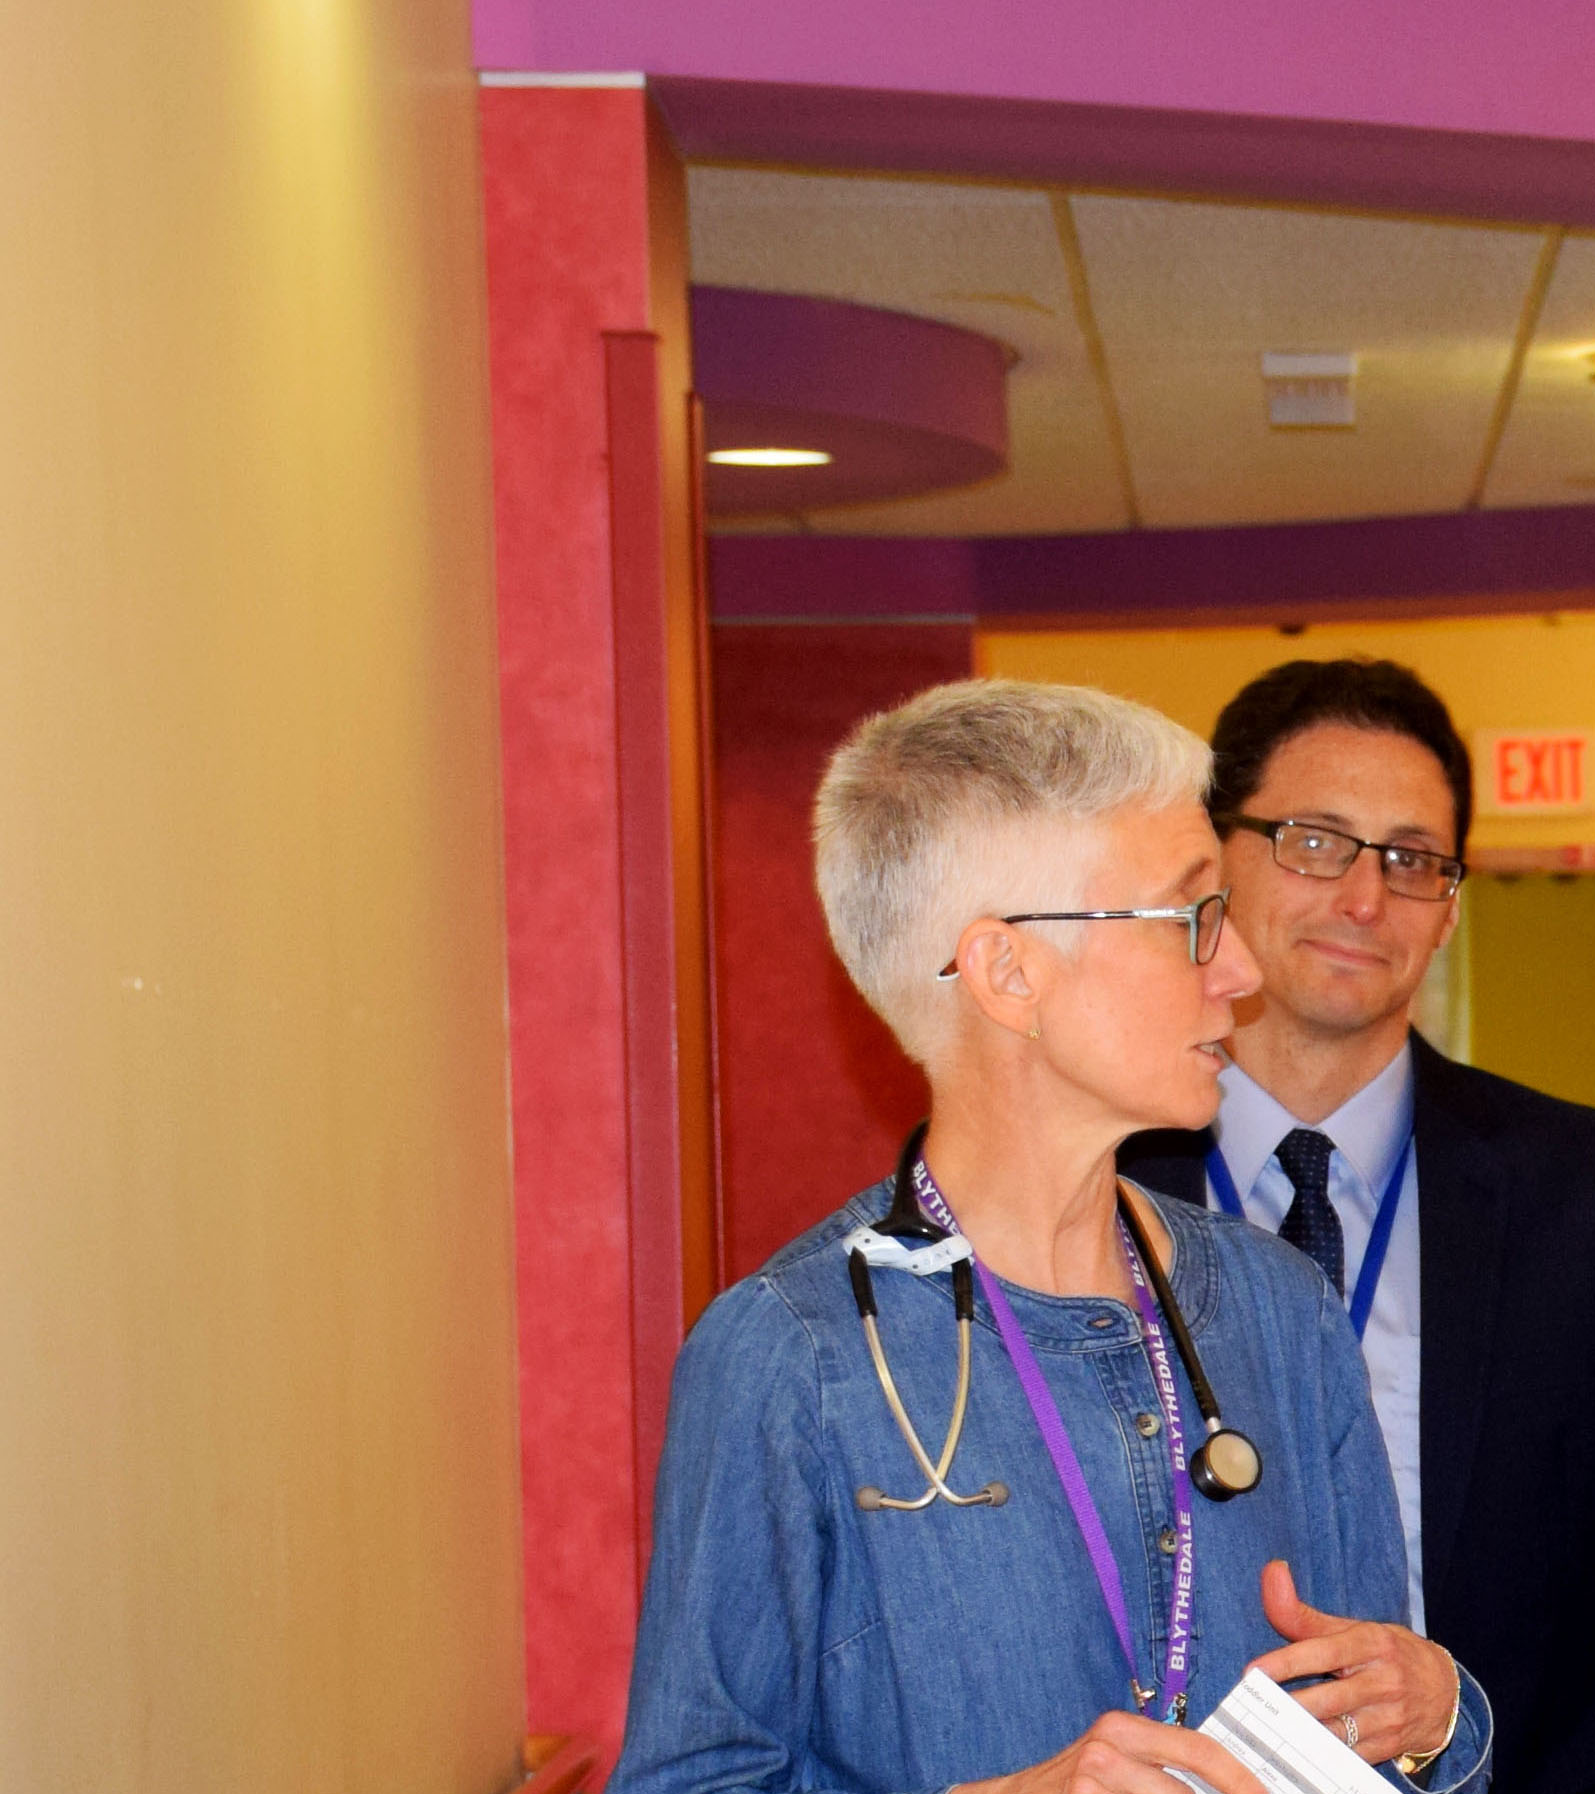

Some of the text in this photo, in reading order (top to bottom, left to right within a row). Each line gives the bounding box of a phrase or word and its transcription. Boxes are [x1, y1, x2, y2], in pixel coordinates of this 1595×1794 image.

[1496, 738, 1586, 804] EXIT
[1147, 1320, 1187, 1472] BLYTHEDALE
[1170, 1510, 1193, 1672] BLYTHEDALE
